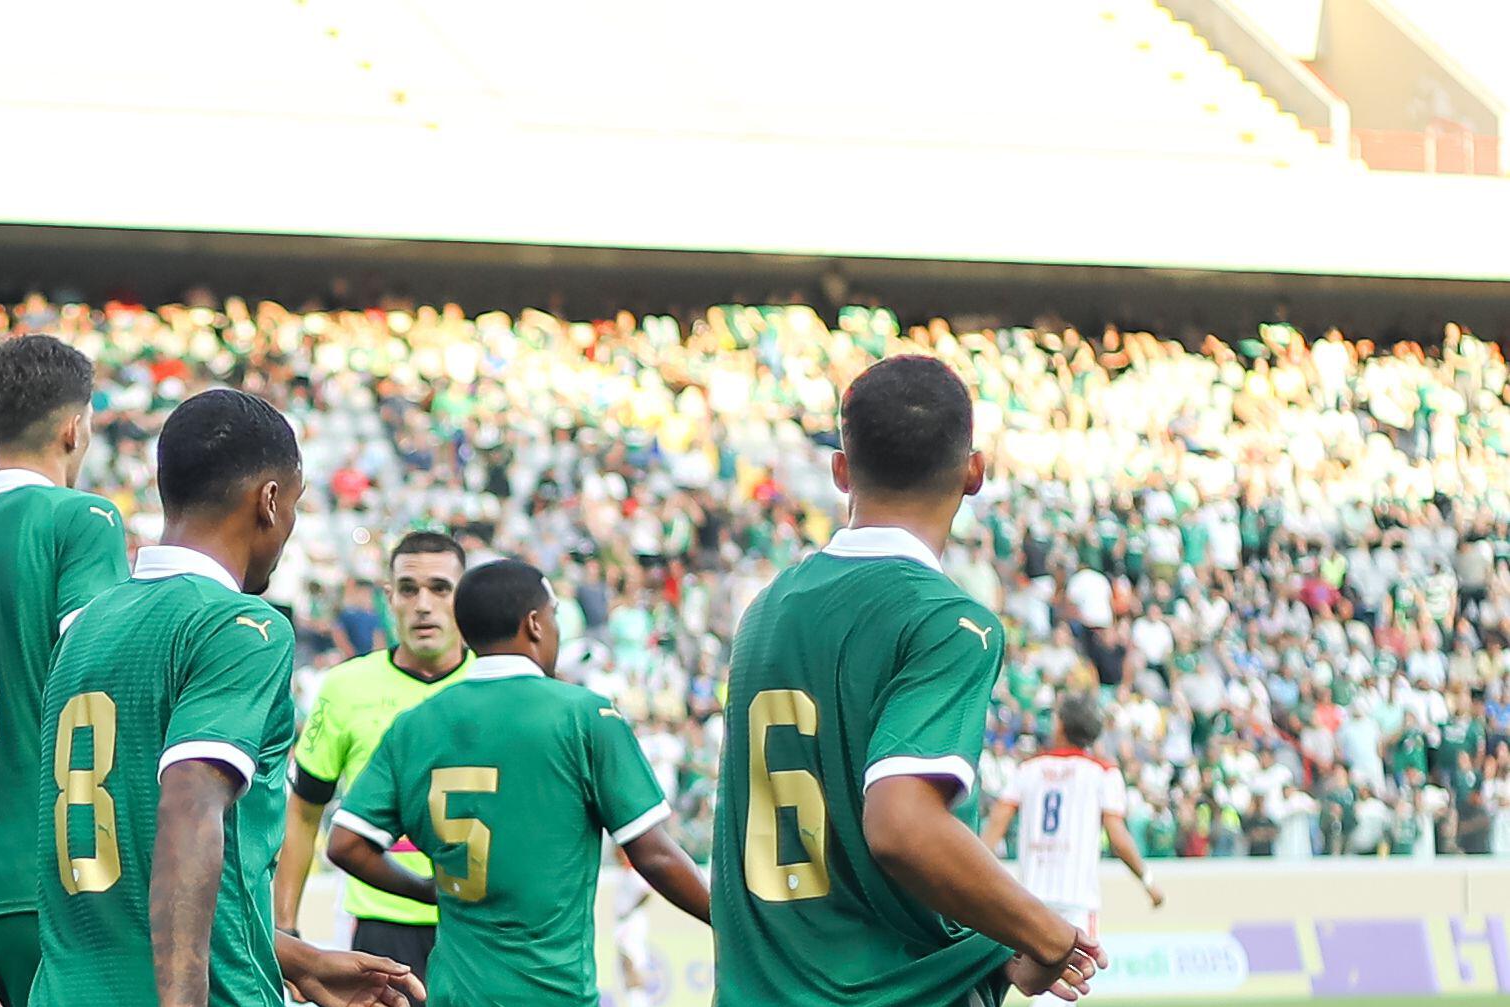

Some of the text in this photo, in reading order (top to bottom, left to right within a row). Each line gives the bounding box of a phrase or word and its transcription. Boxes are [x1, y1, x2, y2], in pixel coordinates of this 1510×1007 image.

[54, 691, 121, 894] 8
[428, 767, 498, 902] 5
[744, 689, 830, 902] 6
[1042, 790, 1062, 835] 8
